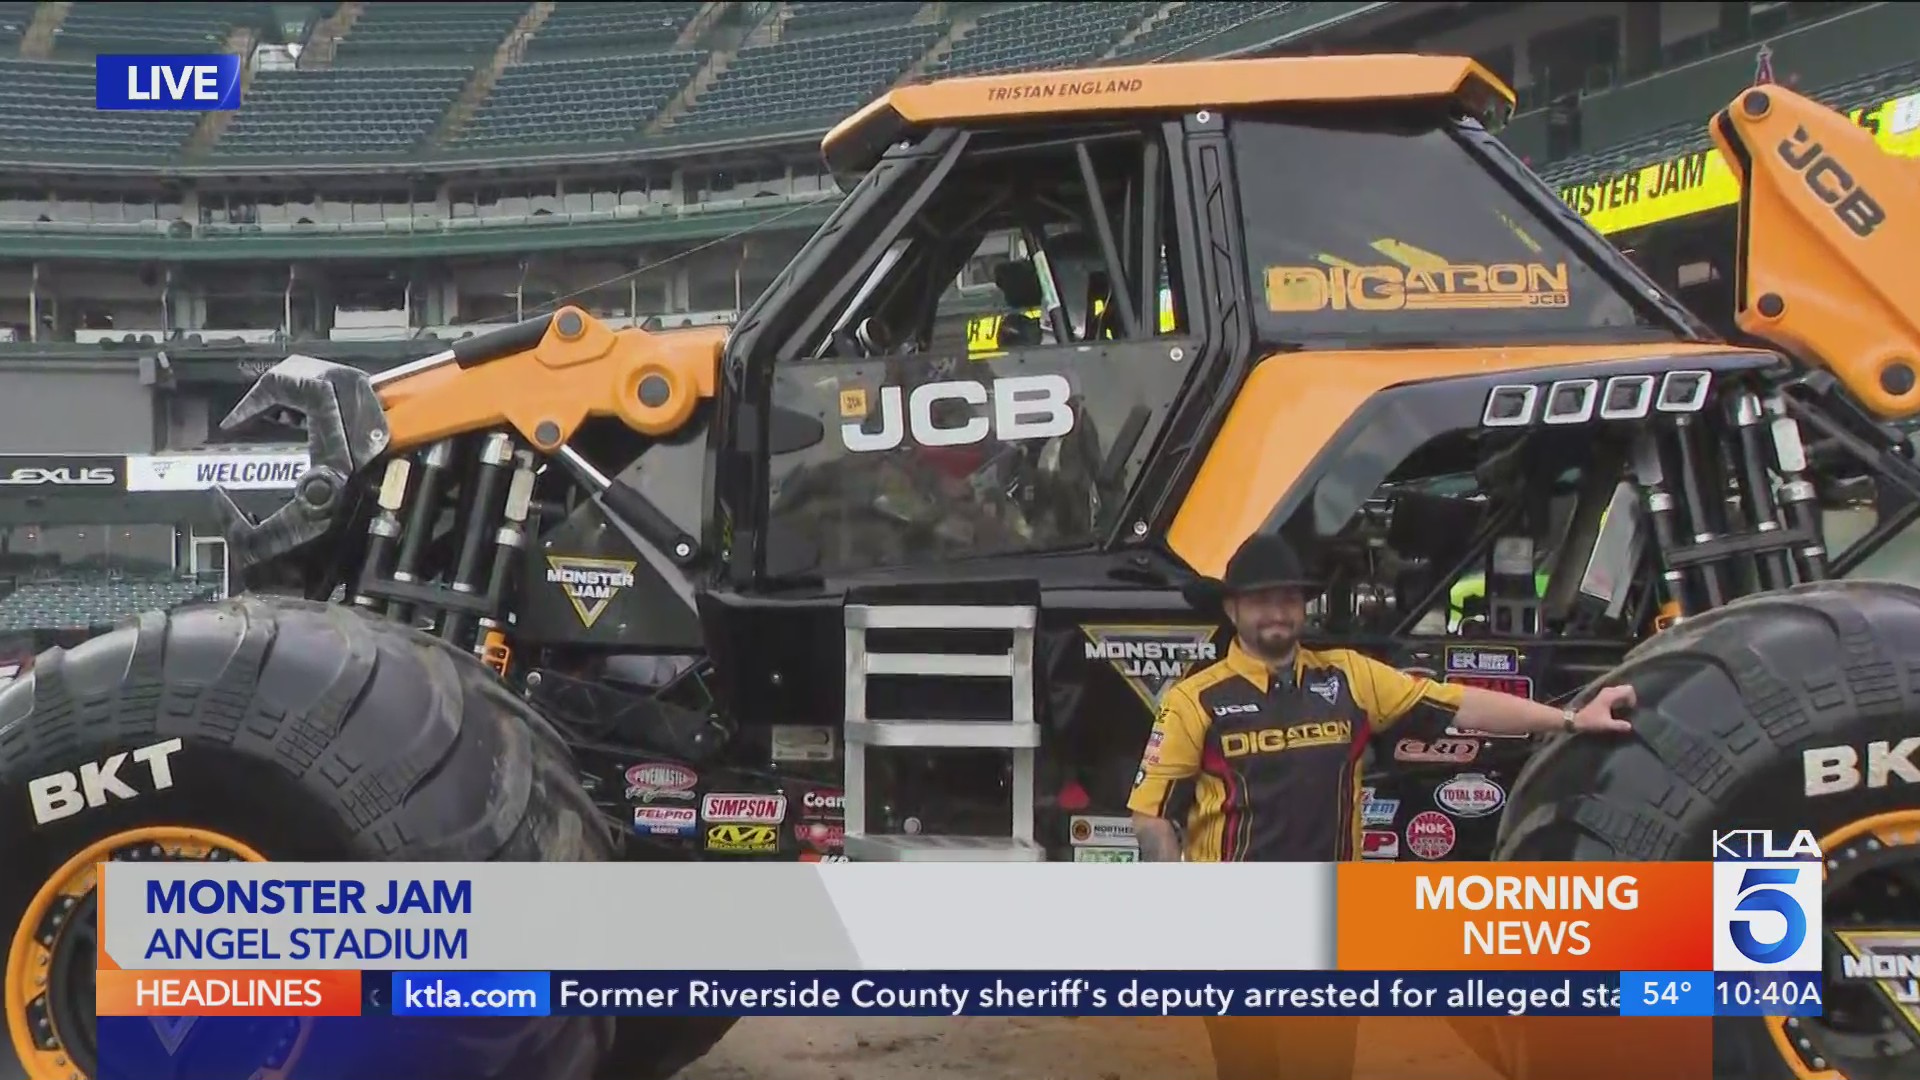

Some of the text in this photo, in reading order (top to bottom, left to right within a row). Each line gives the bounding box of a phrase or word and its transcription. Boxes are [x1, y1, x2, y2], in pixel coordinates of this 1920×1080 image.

[988, 79, 1143, 101] TRISTAN ENGLAND
[1561, 149, 1708, 216] NSTER JAM
[1777, 125, 1887, 238] JCB
[1265, 262, 1569, 312] DIGATRON
[841, 375, 1075, 453] JCB
[197, 461, 305, 483] WELCOME
[546, 568, 635, 588] MONSTER
[571, 585, 611, 598] JAM
[1085, 641, 1217, 661] MONSTER
[1123, 660, 1184, 677] JAM
[1220, 719, 1353, 759] DIGATRON
[1803, 736, 1920, 797] BK
[27, 737, 183, 825] BKT
[1443, 788, 1497, 802] TOTAL SEAL
[708, 798, 779, 818] SIMPSON
[1414, 822, 1447, 834] NGK
